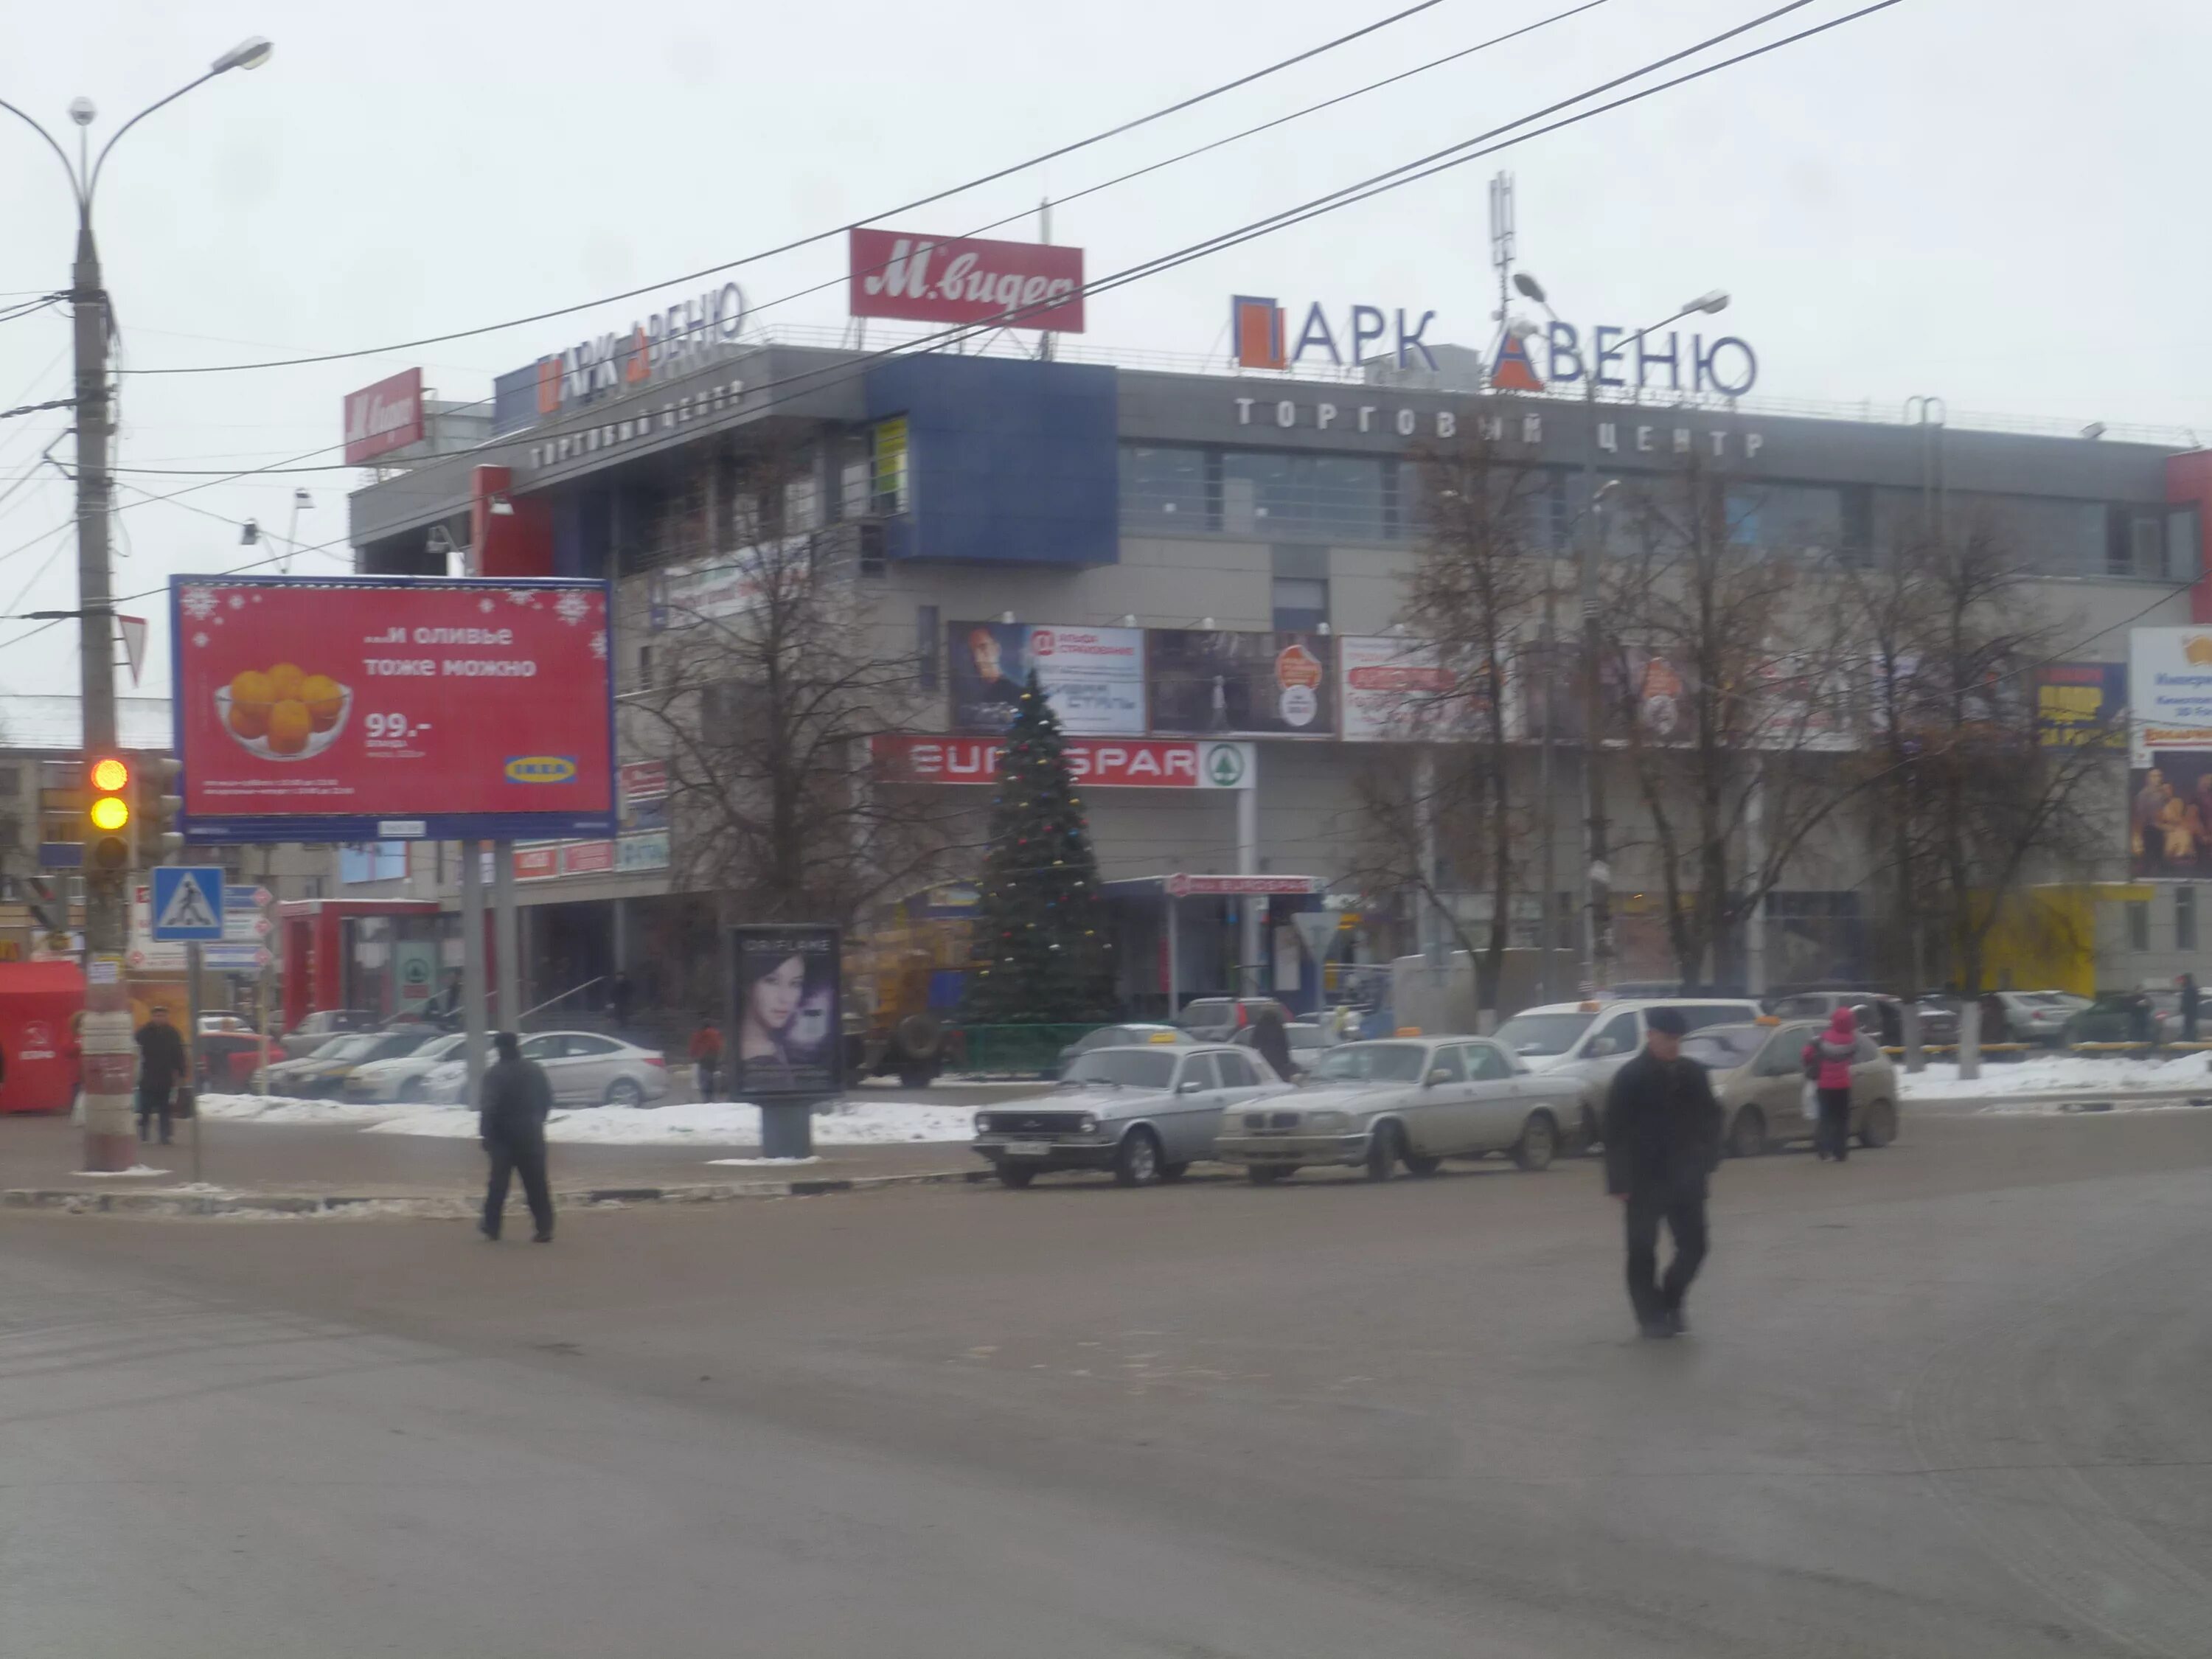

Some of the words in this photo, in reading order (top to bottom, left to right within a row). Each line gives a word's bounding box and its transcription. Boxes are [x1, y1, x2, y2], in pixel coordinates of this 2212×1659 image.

[1231, 295, 1440, 371] ПАРК
[1491, 320, 1758, 395] АВЕНЮ
[1236, 397, 1542, 443] ТОРГОВЫЙ
[1598, 422, 1763, 458] ЦЕНТР
[414, 627, 512, 644] оливье
[364, 659, 437, 676] тоже
[442, 659, 537, 677] можно
[515, 764, 568, 775] IKEA
[908, 745, 1195, 777] EUSPAR
